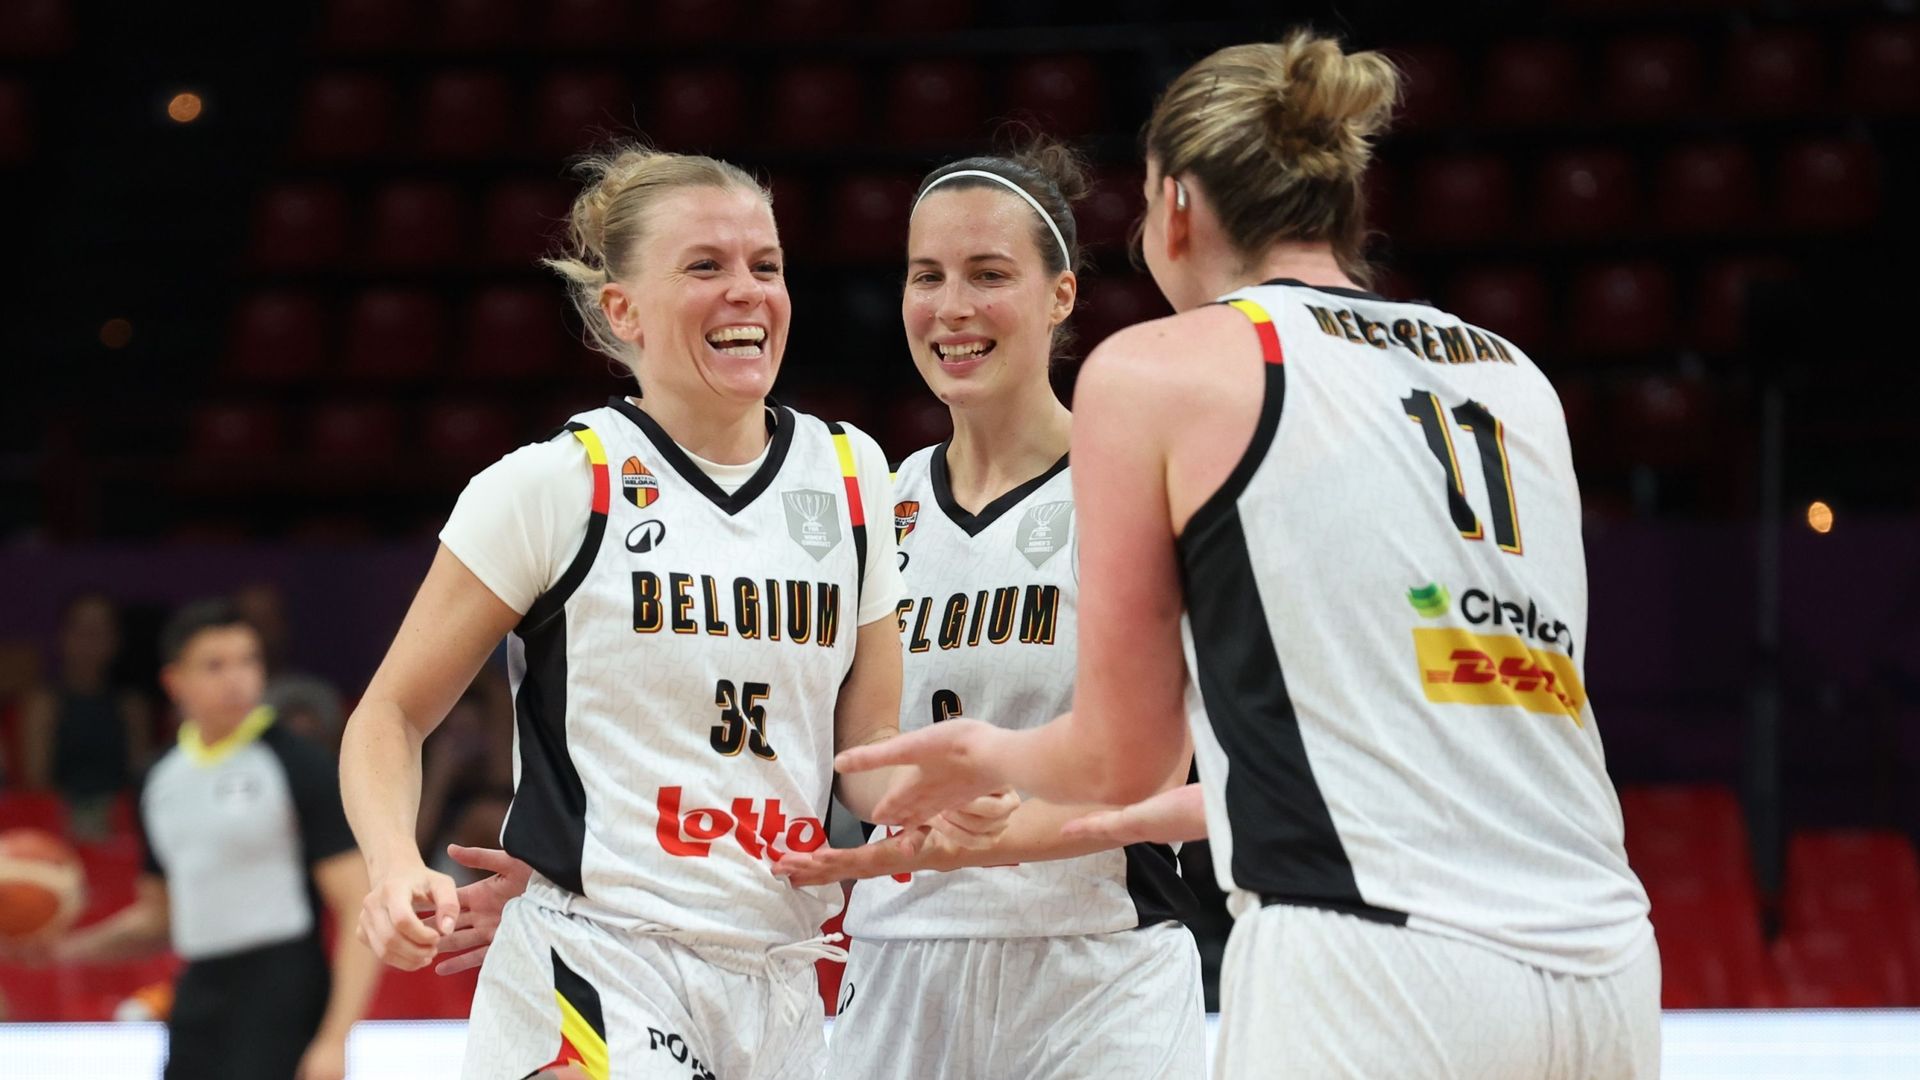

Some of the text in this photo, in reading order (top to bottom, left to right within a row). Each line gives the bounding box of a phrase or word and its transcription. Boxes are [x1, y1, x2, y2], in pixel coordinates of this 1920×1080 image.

[1304, 303, 1518, 366] MEESEMAN
[1400, 388, 1524, 557] 11
[631, 570, 841, 648] BELGIUM
[896, 585, 1060, 654] ELGIUM
[709, 678, 778, 761] 35
